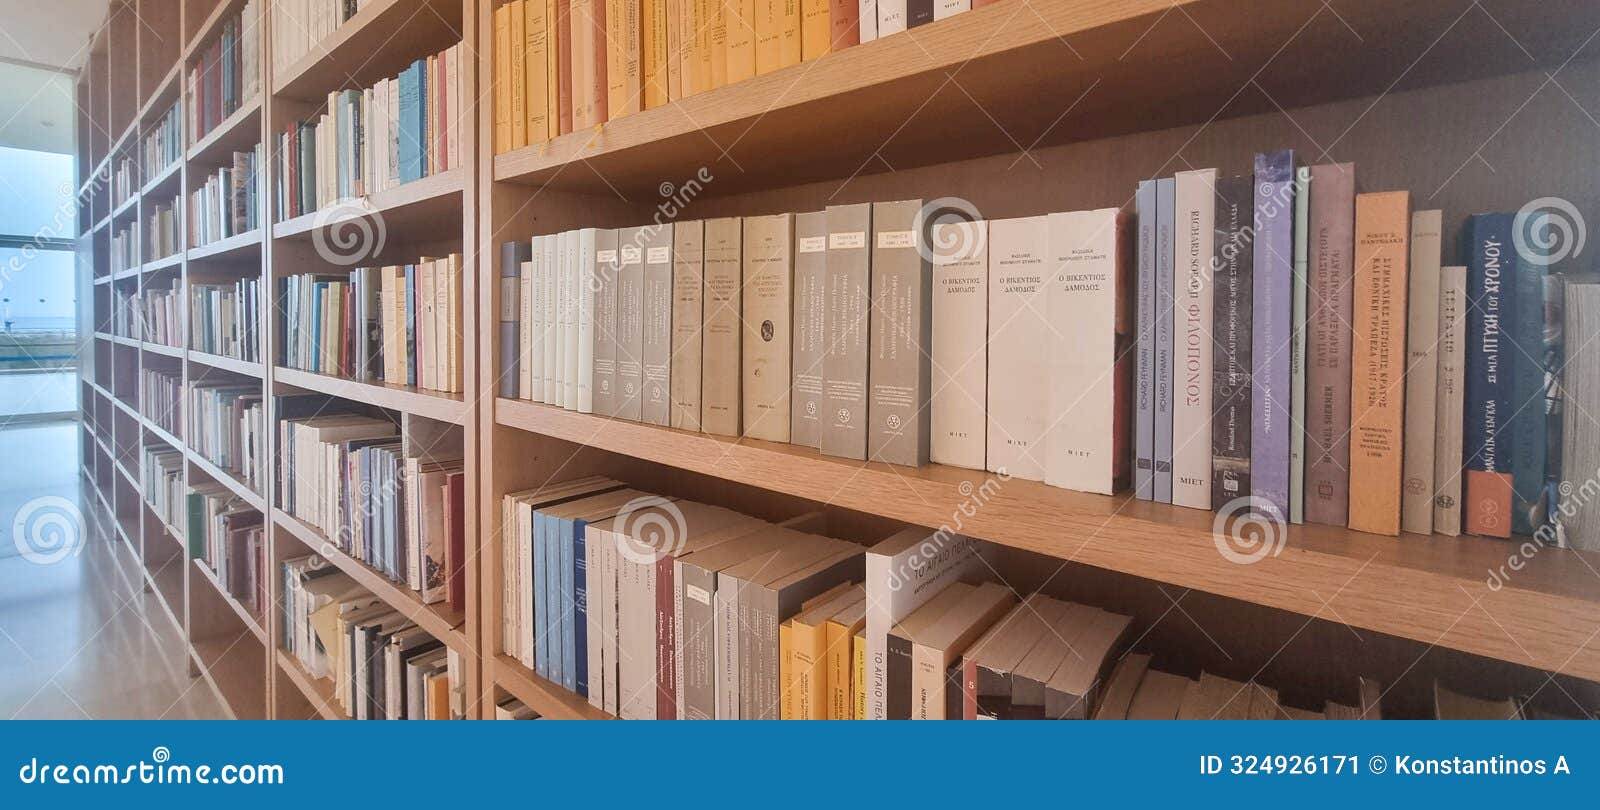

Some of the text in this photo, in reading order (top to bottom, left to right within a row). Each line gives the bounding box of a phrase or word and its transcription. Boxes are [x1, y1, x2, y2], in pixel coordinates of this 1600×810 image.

[1190, 210, 1200, 257] RICHARD
[948, 277, 980, 285] ΒΙΚΕΝΤΙΟΣ
[1066, 273, 1105, 282] ΒΙΚΕΝΤΙΟΣ
[1484, 241, 1502, 293] ΧΡΟΝΟΥ
[1370, 277, 1380, 311] ΕΘΝΙΚΗ
[1381, 258, 1392, 317] ΣΥΜΜΑΧΙΚΕΣ
[1488, 296, 1499, 311] ΤΟΥ
[1369, 316, 1379, 357] ΤΡΑΠΕΖΑ
[1483, 314, 1498, 353] ΠΤΥΧΗ
[1139, 348, 1148, 380] FEYNMAN
[1159, 349, 1168, 381] FEYNMAN
[1186, 304, 1201, 407] ΦΙΛΟΠΟΝΟΣ
[1488, 355, 1497, 372] ΜΙΑ
[1180, 476, 1204, 486] ΜΙΕΤ
[873, 651, 883, 720] ΤΟ ΑΙΓΑΙΟ ΠΕΛ
